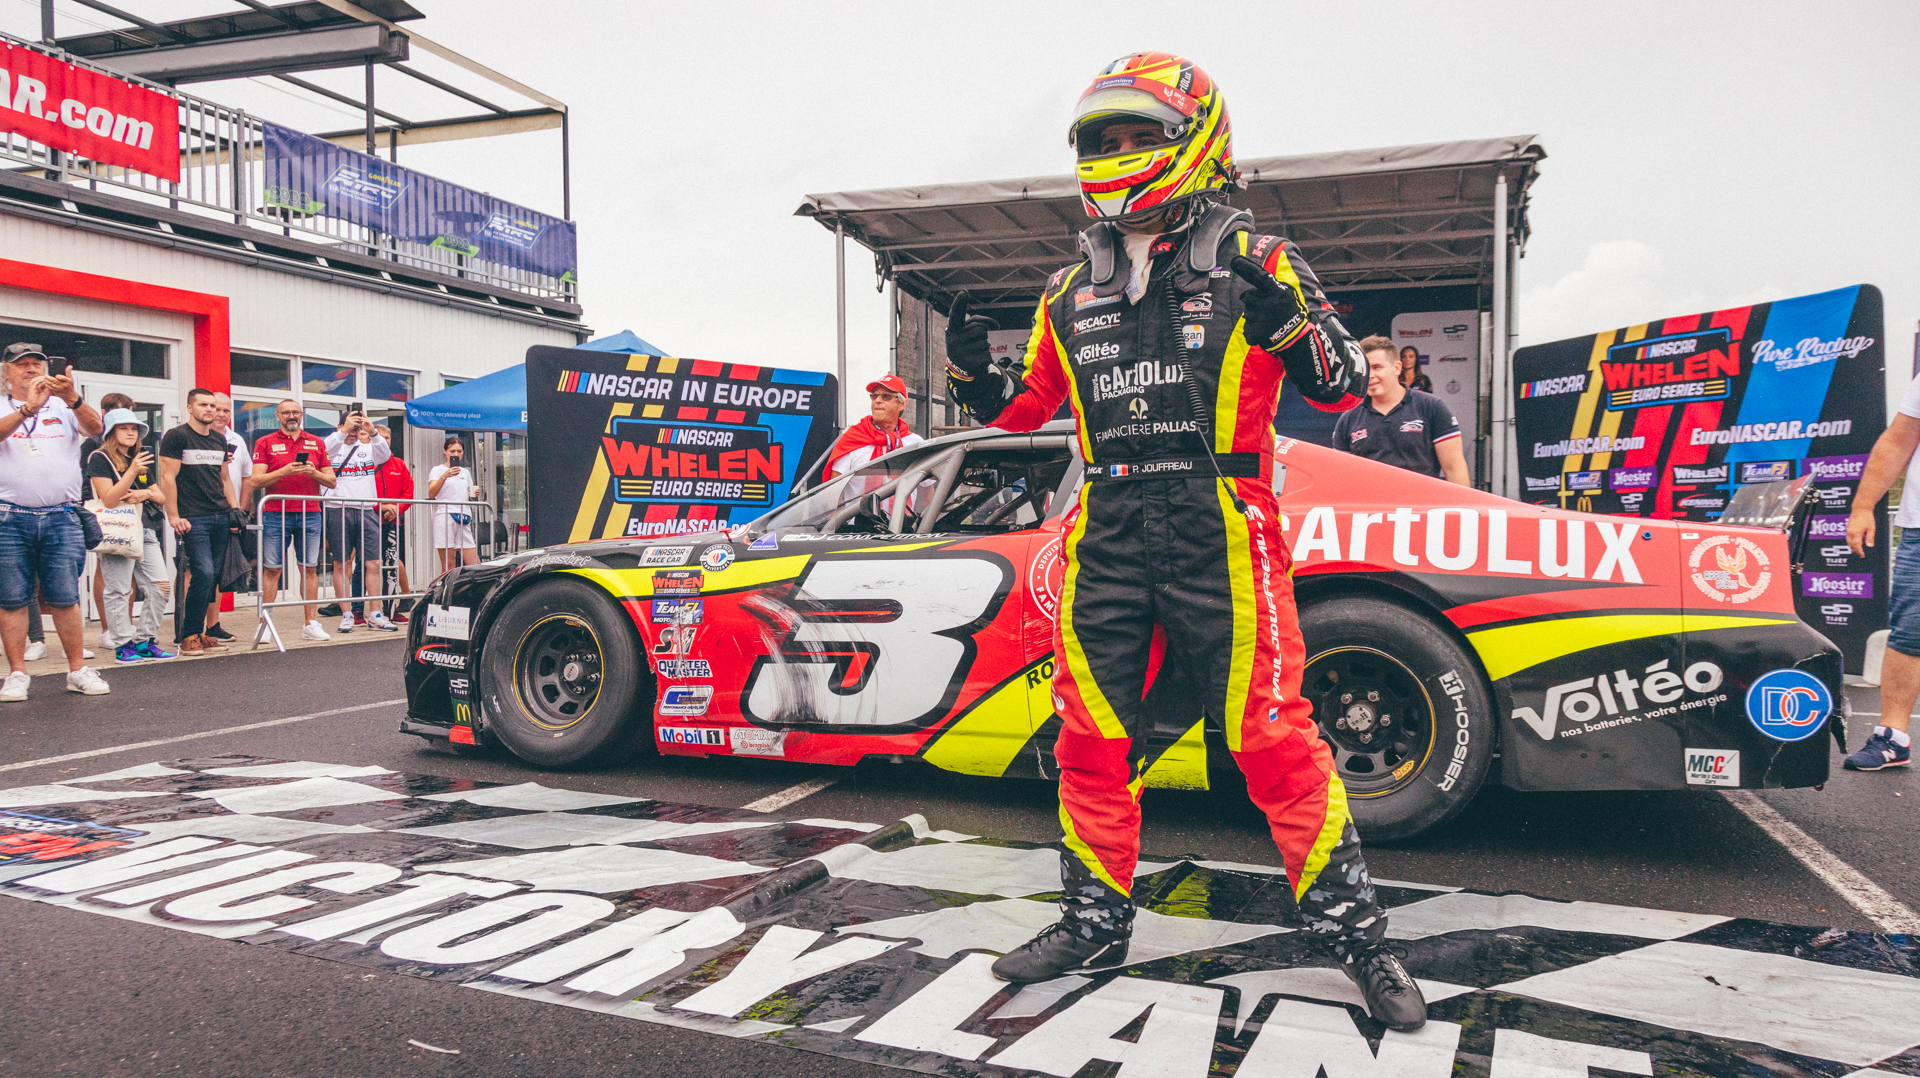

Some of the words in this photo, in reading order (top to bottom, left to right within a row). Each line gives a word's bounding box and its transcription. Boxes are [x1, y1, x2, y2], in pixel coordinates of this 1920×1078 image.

[368, 173, 401, 187] GOODYEAR
[1075, 342, 1119, 365] Voltéo
[1650, 339, 1697, 358] NASCAR
[1751, 339, 1794, 364] Pure
[1795, 336, 1875, 362] Racing
[1602, 341, 1741, 391] WHELEN
[586, 374, 672, 400] NASCAR
[681, 380, 706, 402] IN
[713, 383, 812, 410] EUROPE
[1102, 386, 1145, 400] PACKAGING
[1534, 374, 1586, 397] NASCAR
[1631, 387, 1661, 402] EURO
[1661, 382, 1705, 398] SERIES
[1153, 421, 1197, 434] PALLAS
[1690, 419, 1852, 445] EuroNASCAR.com
[677, 429, 733, 447] NASCAR
[1533, 436, 1646, 458] EuroNASCAR.com
[602, 436, 783, 482] WHELEN
[1132, 465, 1139, 473] P.
[1141, 461, 1193, 474] JOUFFREAU
[1809, 459, 1864, 477] Hoosier
[1525, 475, 1561, 487] WHELEN
[1613, 470, 1653, 486] Hoosier
[1673, 465, 1728, 479] WHELEN
[651, 480, 693, 497] EURO
[695, 482, 742, 498] SERIES
[1680, 498, 1724, 507] KENNOL
[646, 557, 665, 565] RACE
[657, 548, 686, 557] NASCAR
[1038, 544, 1059, 570] DEPUIS
[528, 551, 592, 573] Hoosier
[652, 575, 704, 588] WHELEN
[1808, 576, 1865, 592] Hoosier
[1256, 533, 1281, 651] JOUFFREAU
[438, 615, 468, 624] LIBURNIA
[748, 559, 1004, 725] 3
[419, 650, 466, 667] KENNOL
[658, 660, 708, 672] QUARTER
[667, 669, 711, 678] MASTER
[1271, 653, 1284, 702] PAUL
[1511, 658, 1724, 740] Voltéo
[1762, 687, 1820, 727] DC
[1561, 728, 1582, 738] nos
[1584, 715, 1642, 733] batteries,
[1644, 706, 1677, 719] votre
[1679, 693, 1728, 711] énergie
[662, 728, 702, 744] Mobil
[1437, 694, 1470, 792] HOOSIER
[1687, 755, 1726, 773] MCC
[15, 837, 910, 1018] VICTORY
